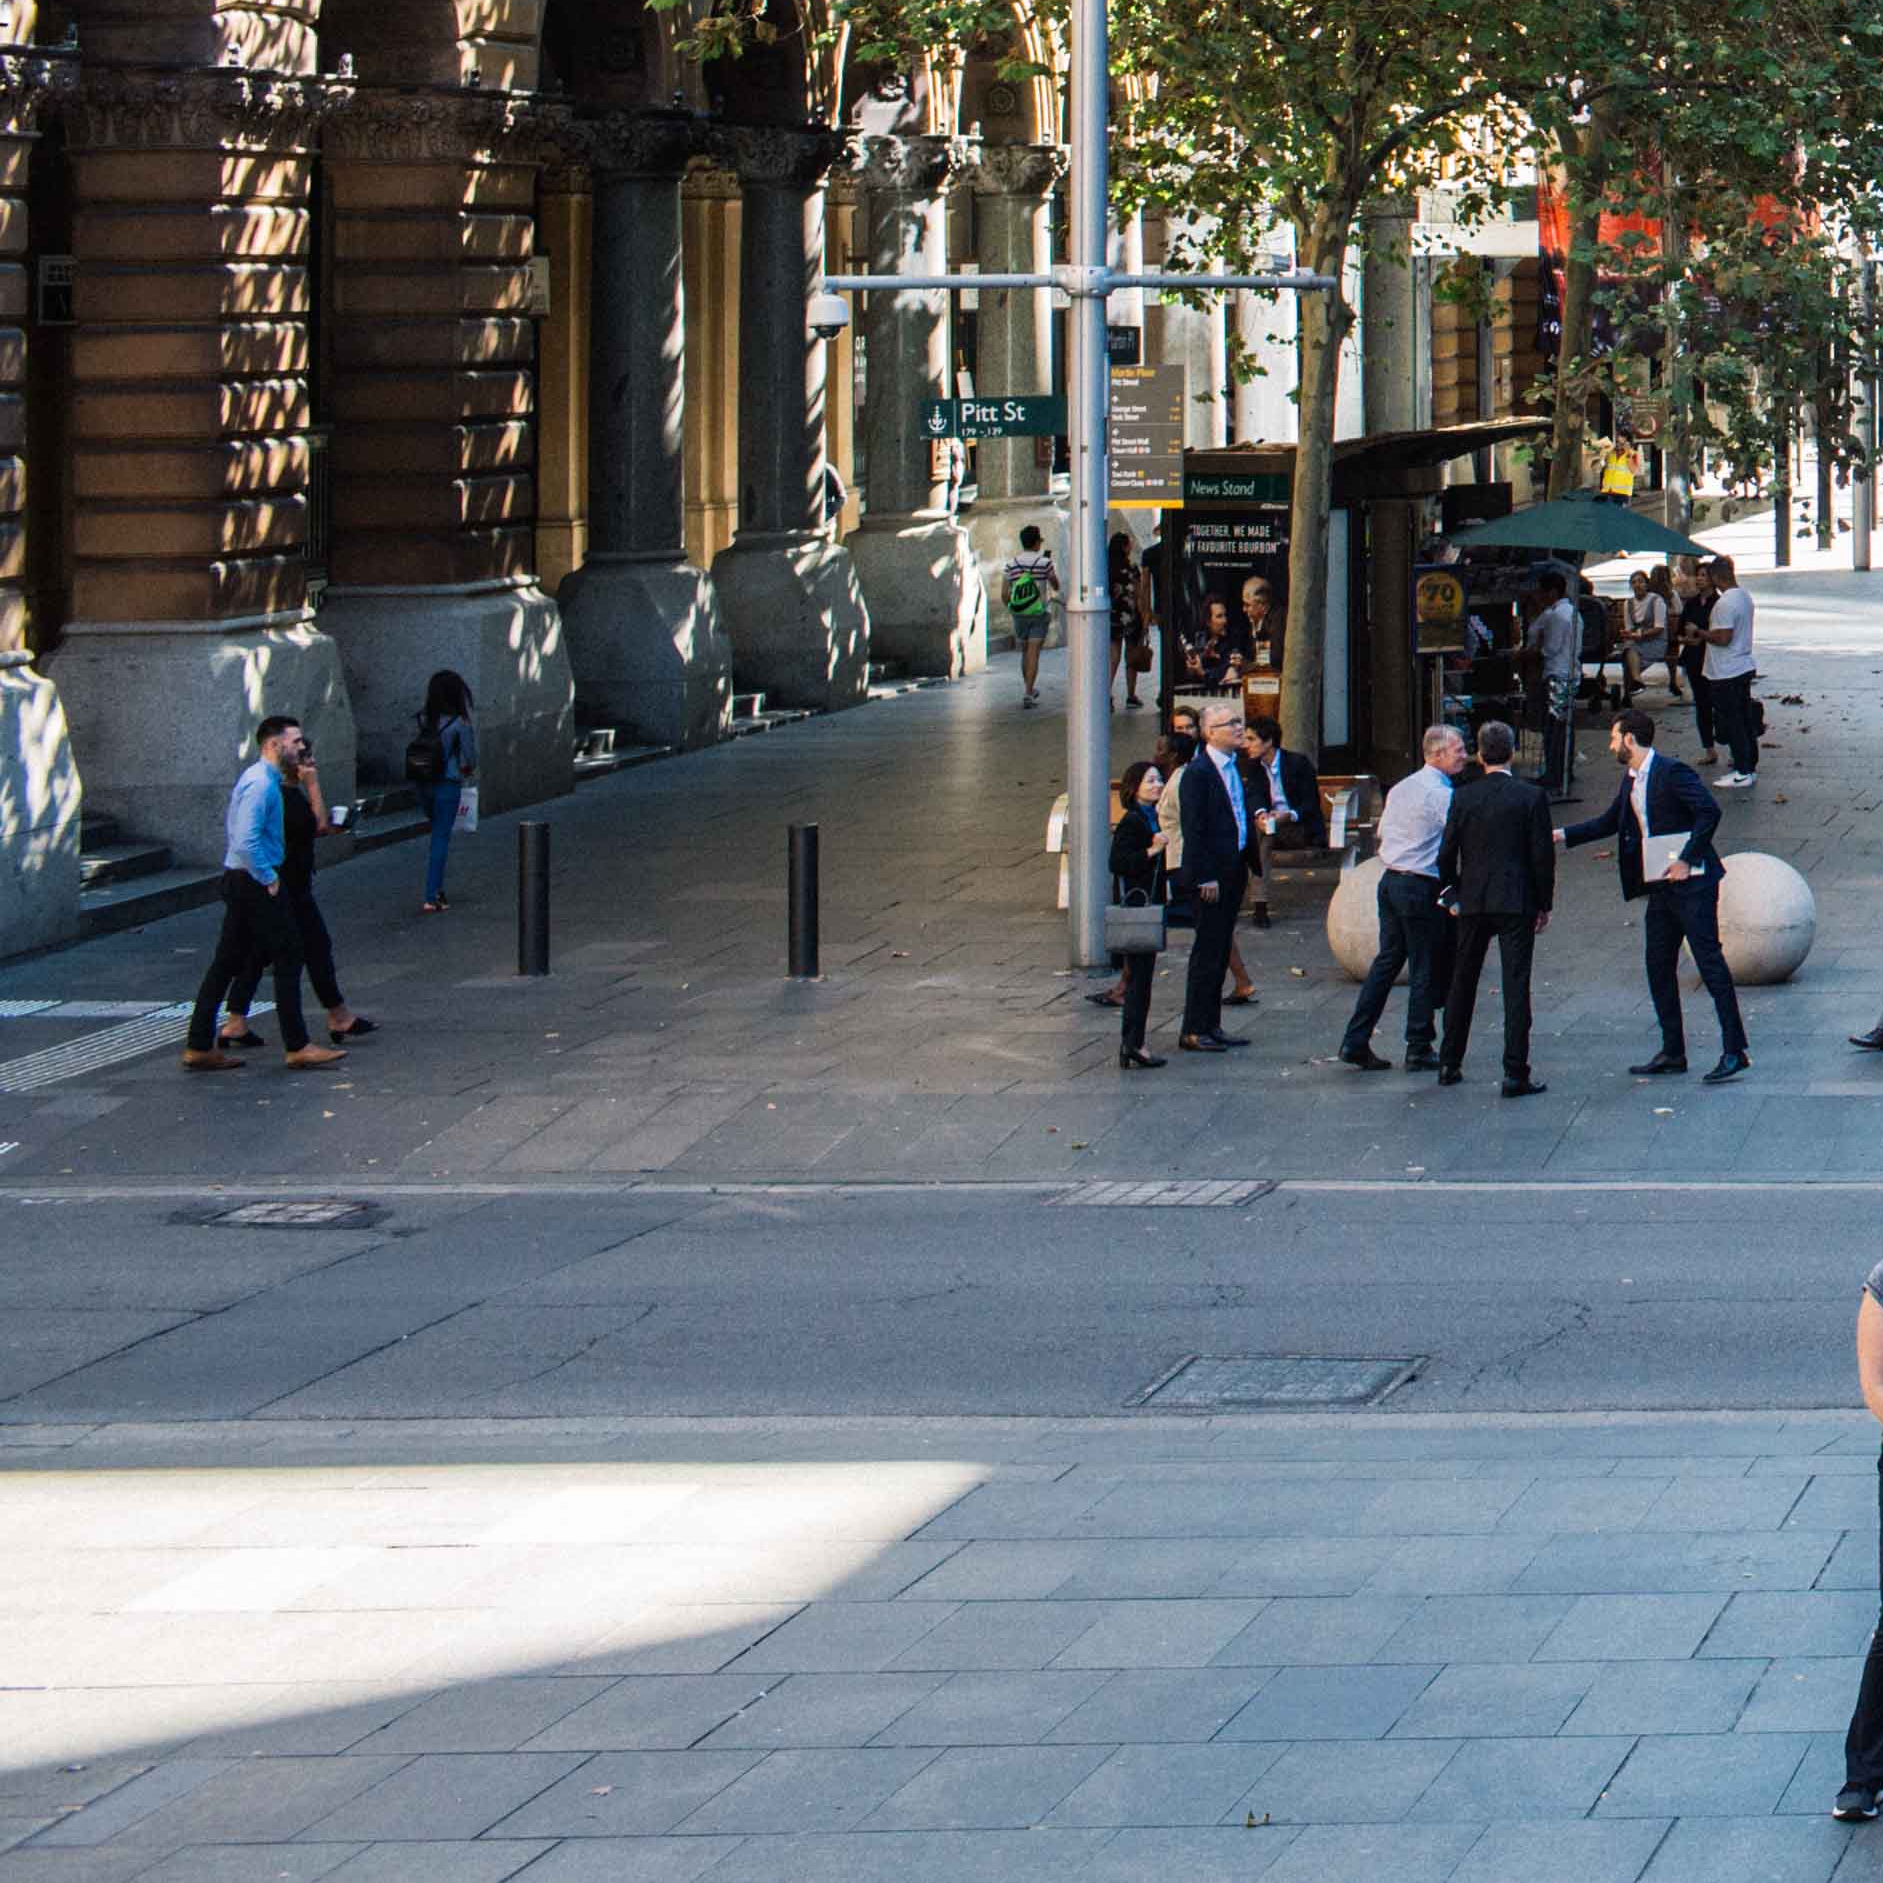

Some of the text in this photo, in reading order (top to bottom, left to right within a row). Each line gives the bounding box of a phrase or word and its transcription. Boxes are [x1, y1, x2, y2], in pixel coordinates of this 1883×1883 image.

[960, 401, 1027, 423] Pitt St
[1190, 479, 1255, 497] News Stand
[1233, 525, 1246, 537] WE
[1247, 525, 1271, 537] MADE
[1197, 541, 1237, 553] FAVOURITE
